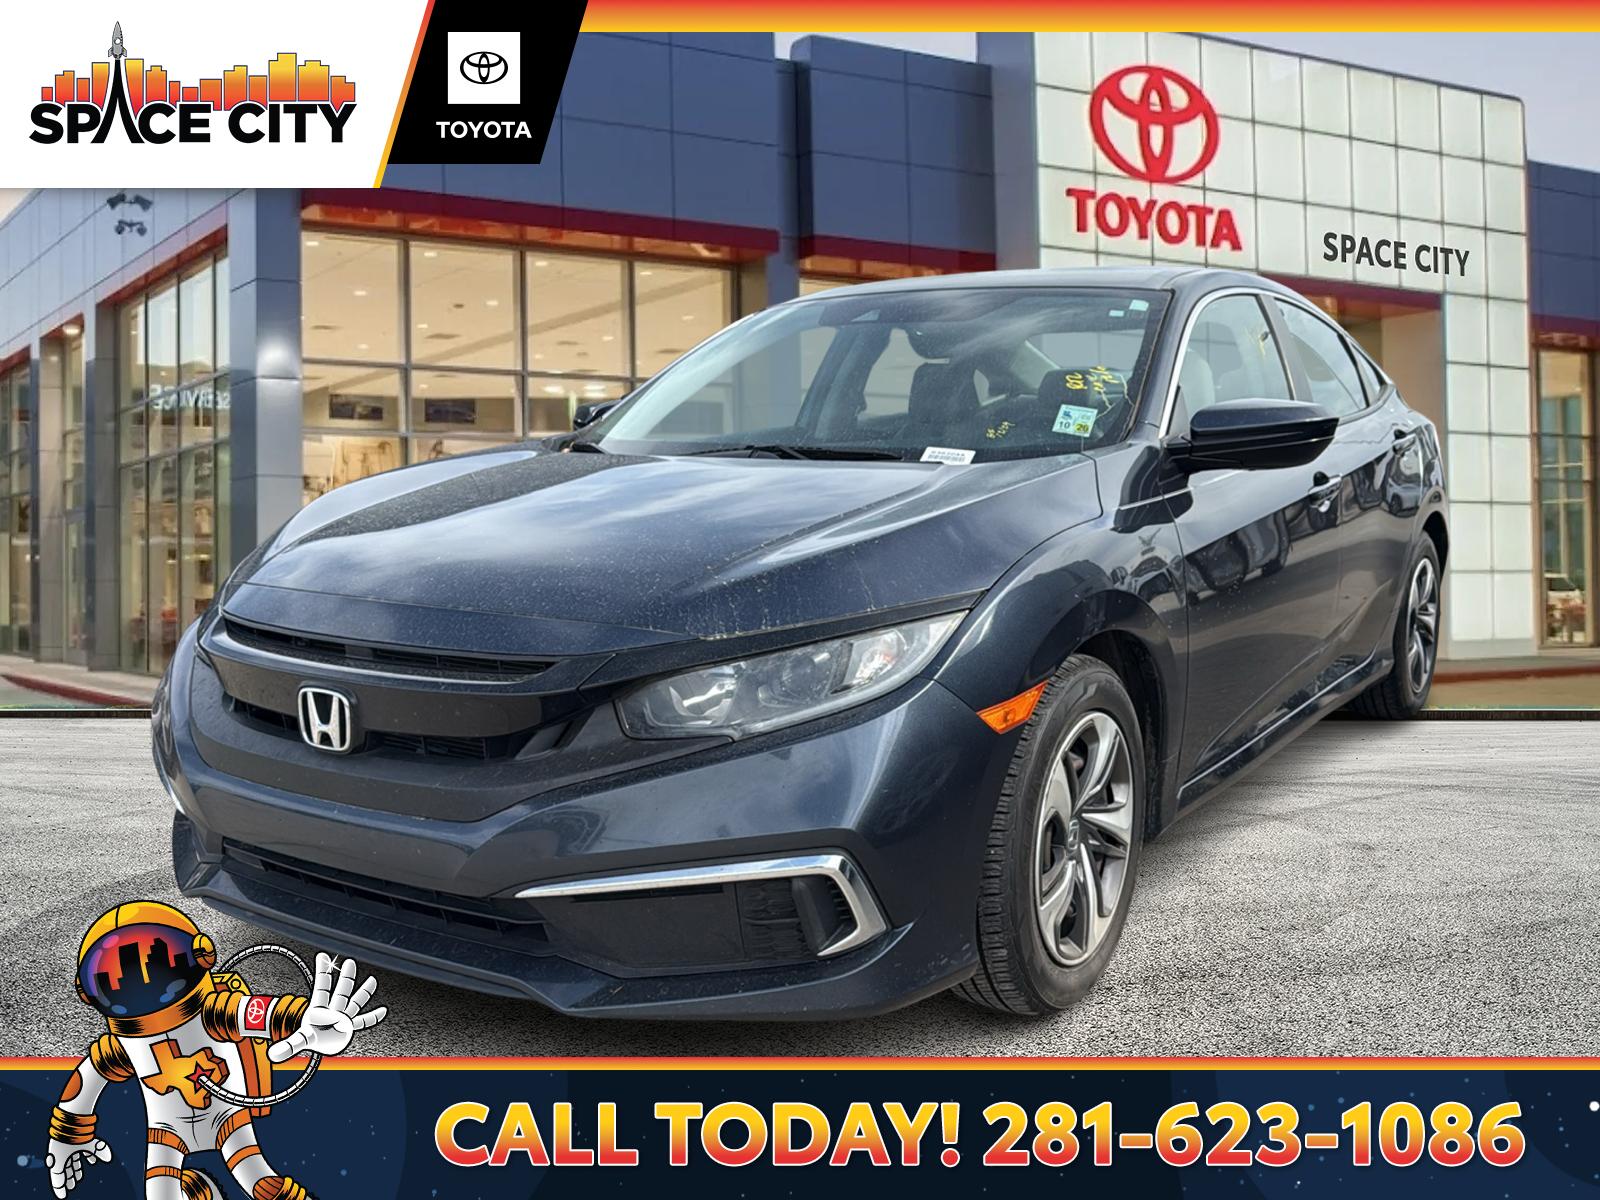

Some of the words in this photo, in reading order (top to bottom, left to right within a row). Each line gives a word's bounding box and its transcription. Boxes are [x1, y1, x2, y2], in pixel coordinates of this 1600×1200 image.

[1066, 187, 1242, 251] TOYOTA
[1323, 232, 1406, 270] SPACE
[1414, 244, 1470, 276] CITY
[1059, 421, 1070, 429] 10
